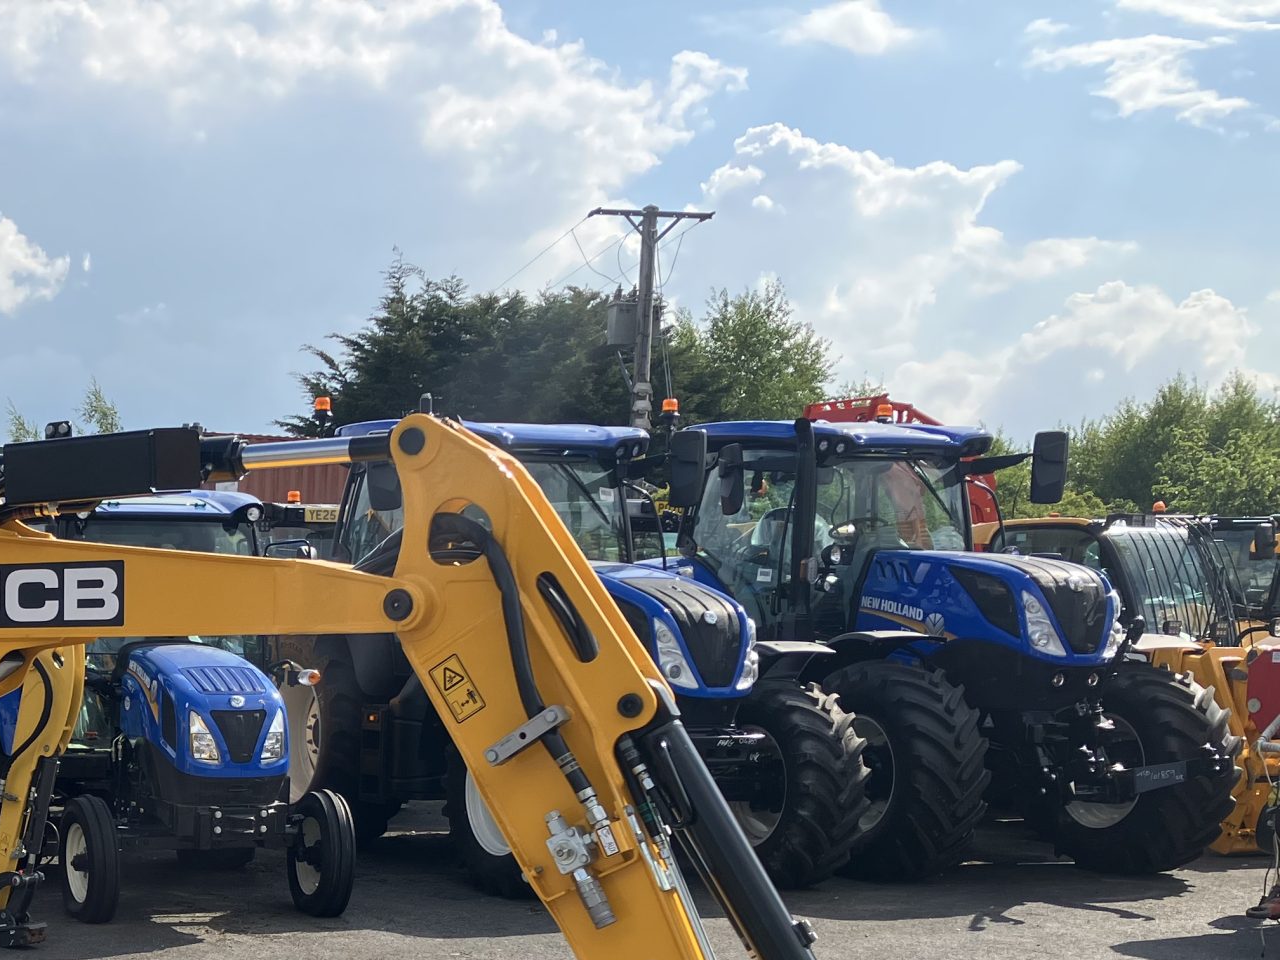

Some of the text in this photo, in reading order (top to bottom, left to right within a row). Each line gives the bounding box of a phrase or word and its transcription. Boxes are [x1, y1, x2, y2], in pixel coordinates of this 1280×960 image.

[309, 509, 336, 521] YE25
[861, 595, 924, 621] NEW HOLLAND
